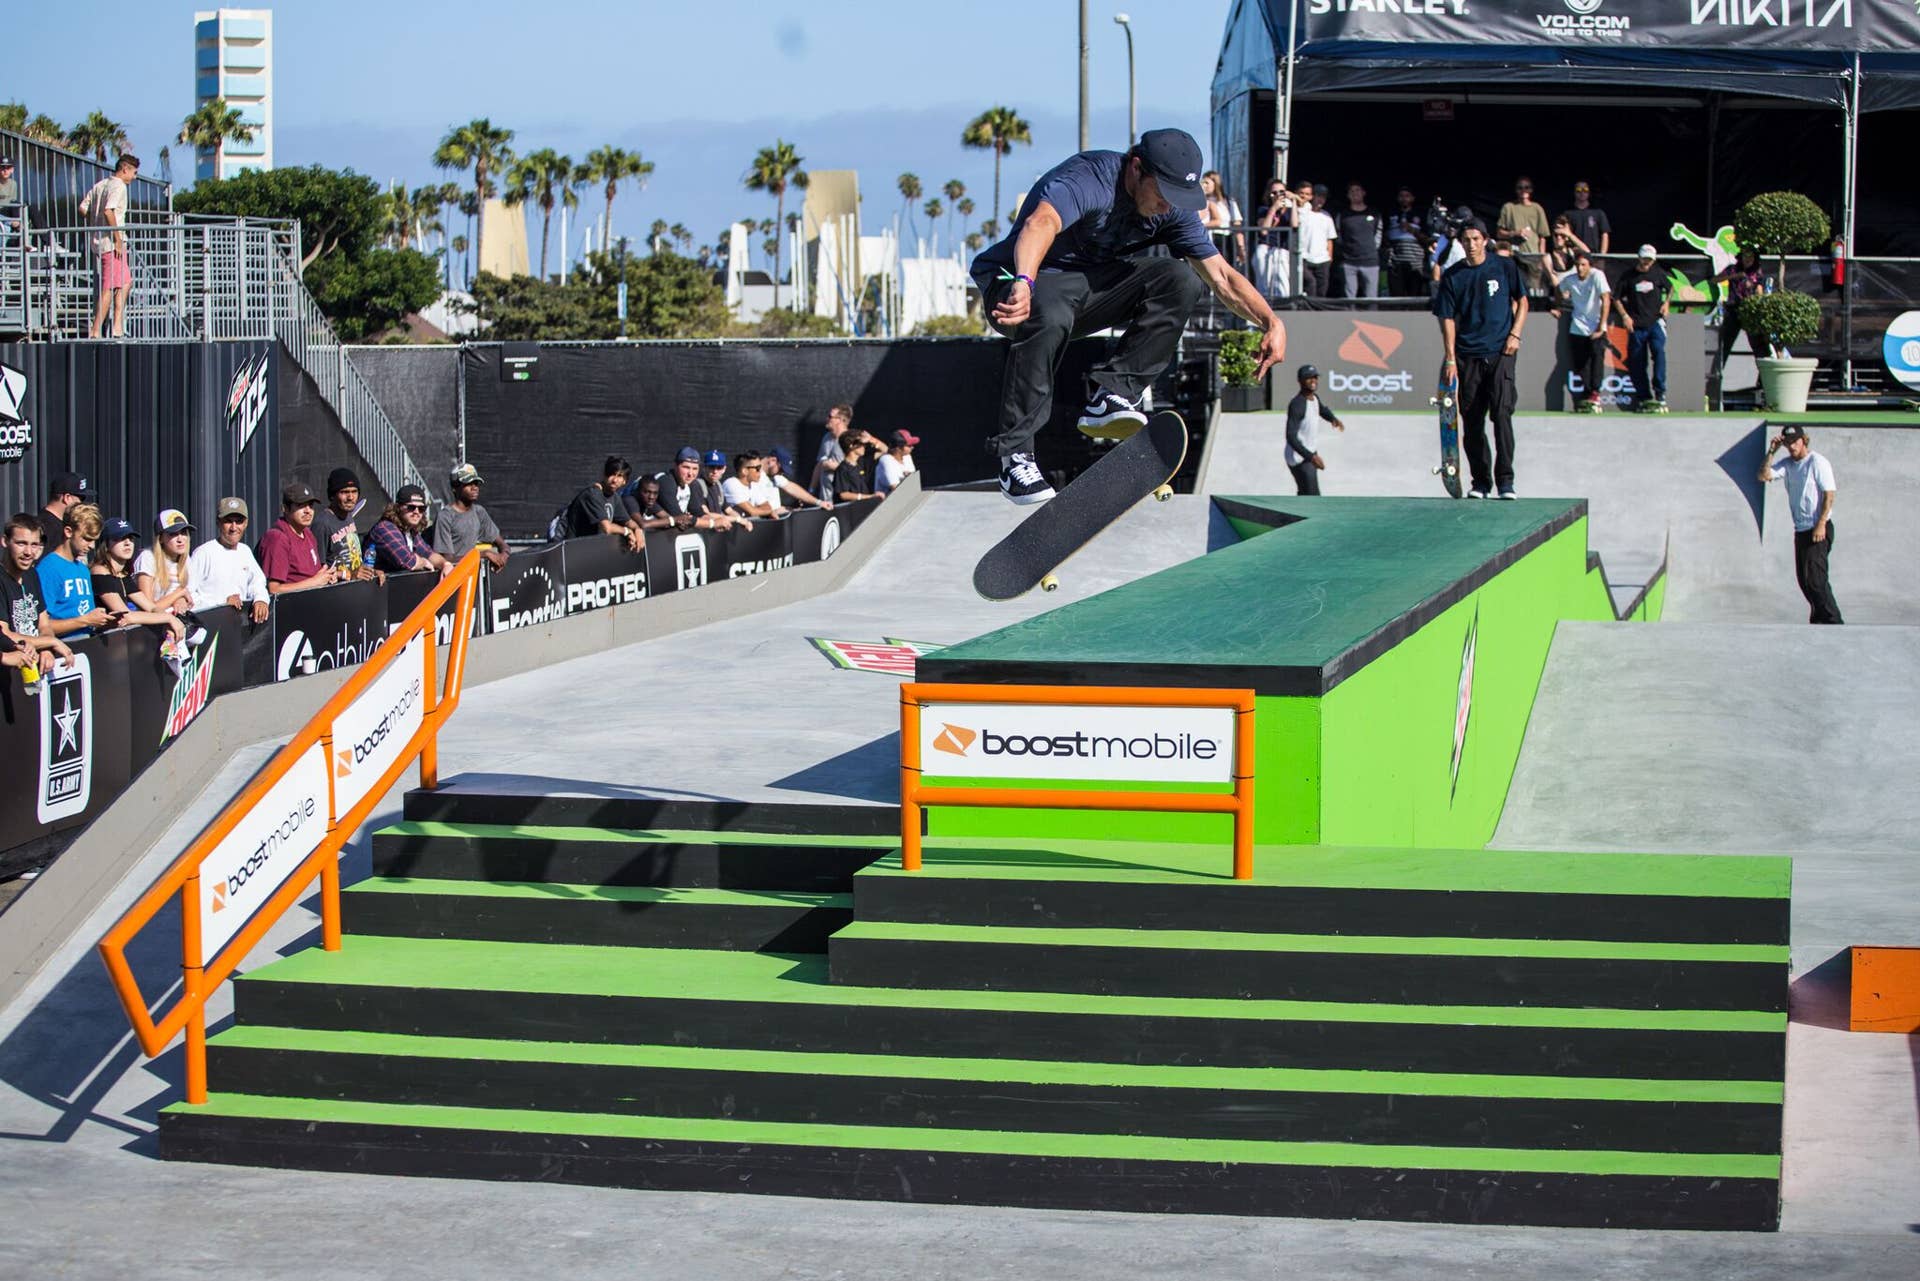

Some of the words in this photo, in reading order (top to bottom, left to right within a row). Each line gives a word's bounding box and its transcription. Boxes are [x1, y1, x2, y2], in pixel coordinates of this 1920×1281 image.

[1536, 14, 1630, 29] VOLCOM
[1577, 29, 1594, 37] TO
[1329, 369, 1413, 392] boost
[240, 357, 268, 453] ICE
[1348, 393, 1393, 405] mobile
[0, 420, 31, 445] oost
